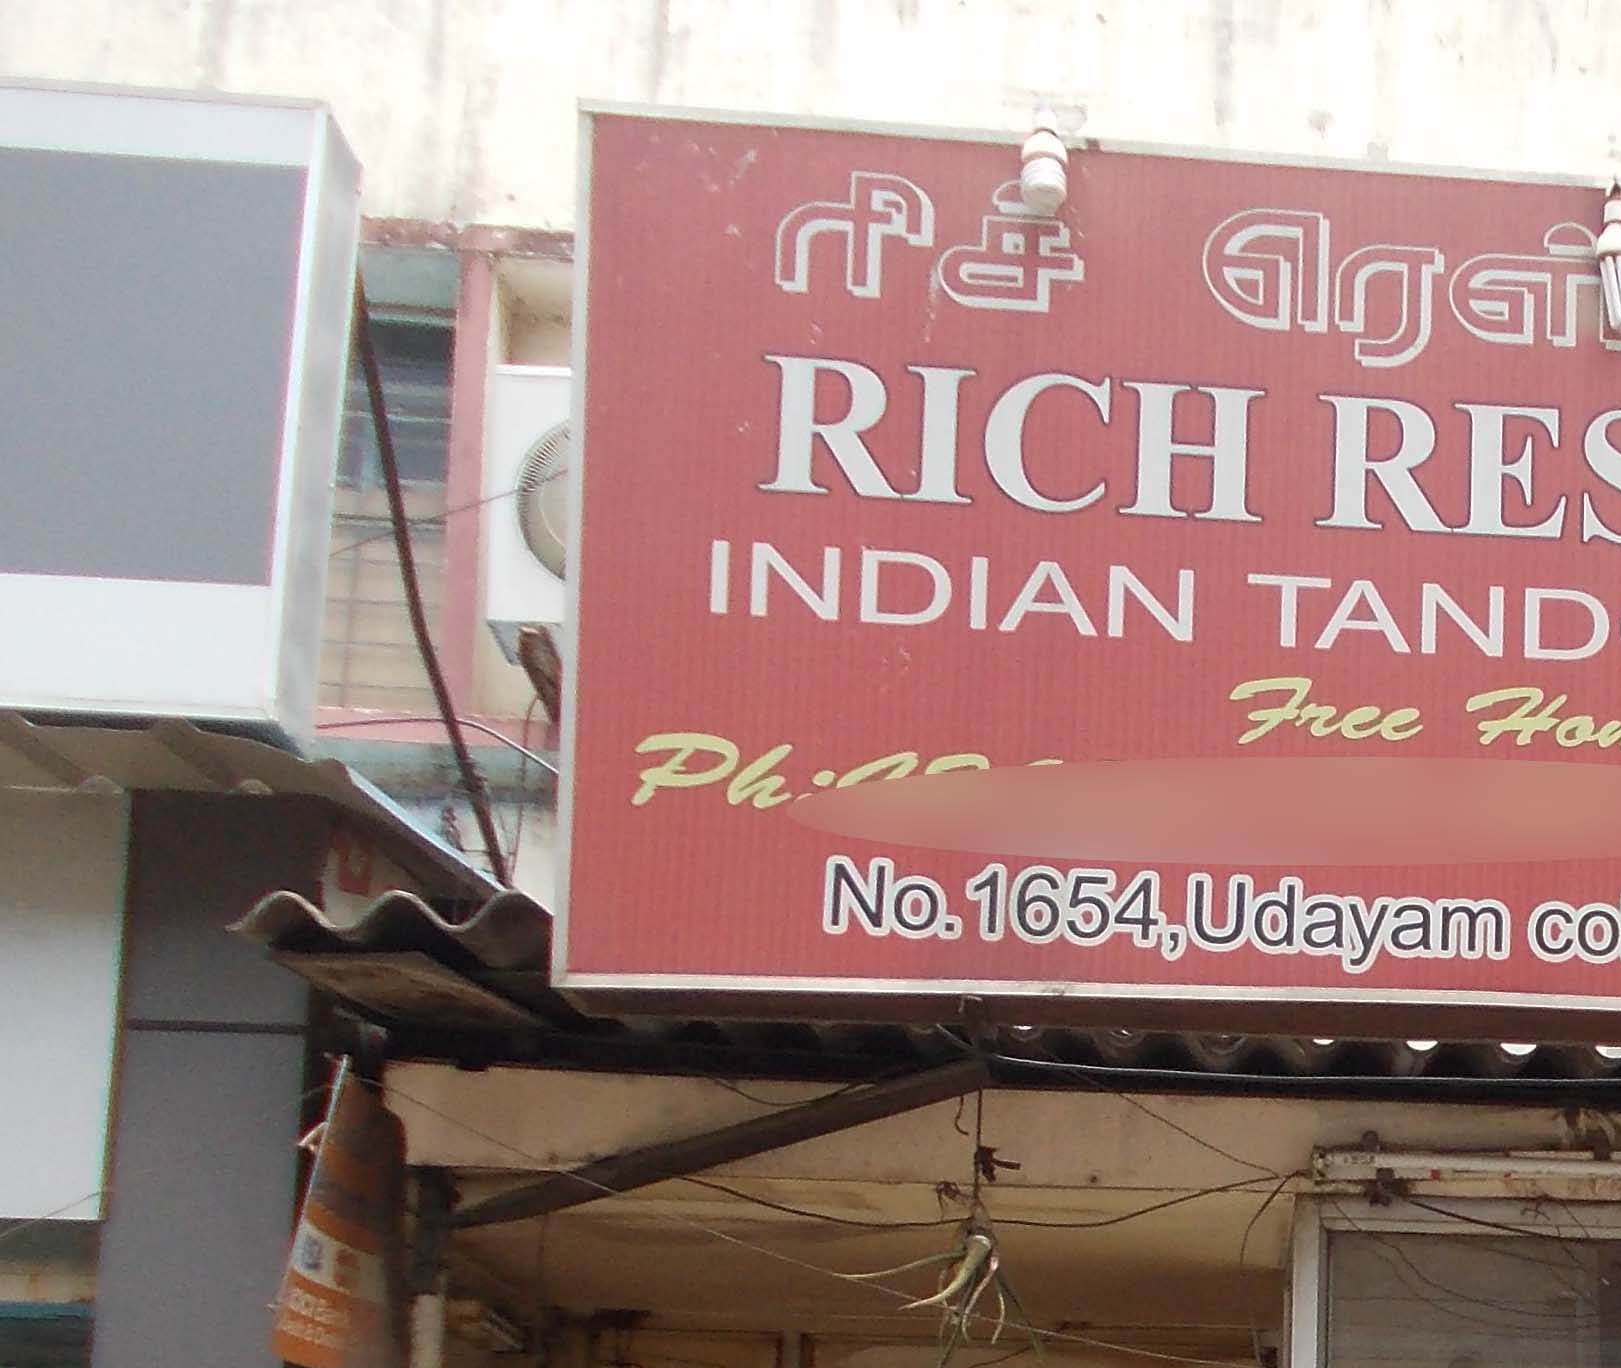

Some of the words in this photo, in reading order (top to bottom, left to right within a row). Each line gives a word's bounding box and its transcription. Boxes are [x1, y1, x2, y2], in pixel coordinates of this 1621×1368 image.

[759, 352, 1265, 525] RICH
[710, 539, 1195, 643] INDIAN
[1229, 676, 1424, 746] Free
